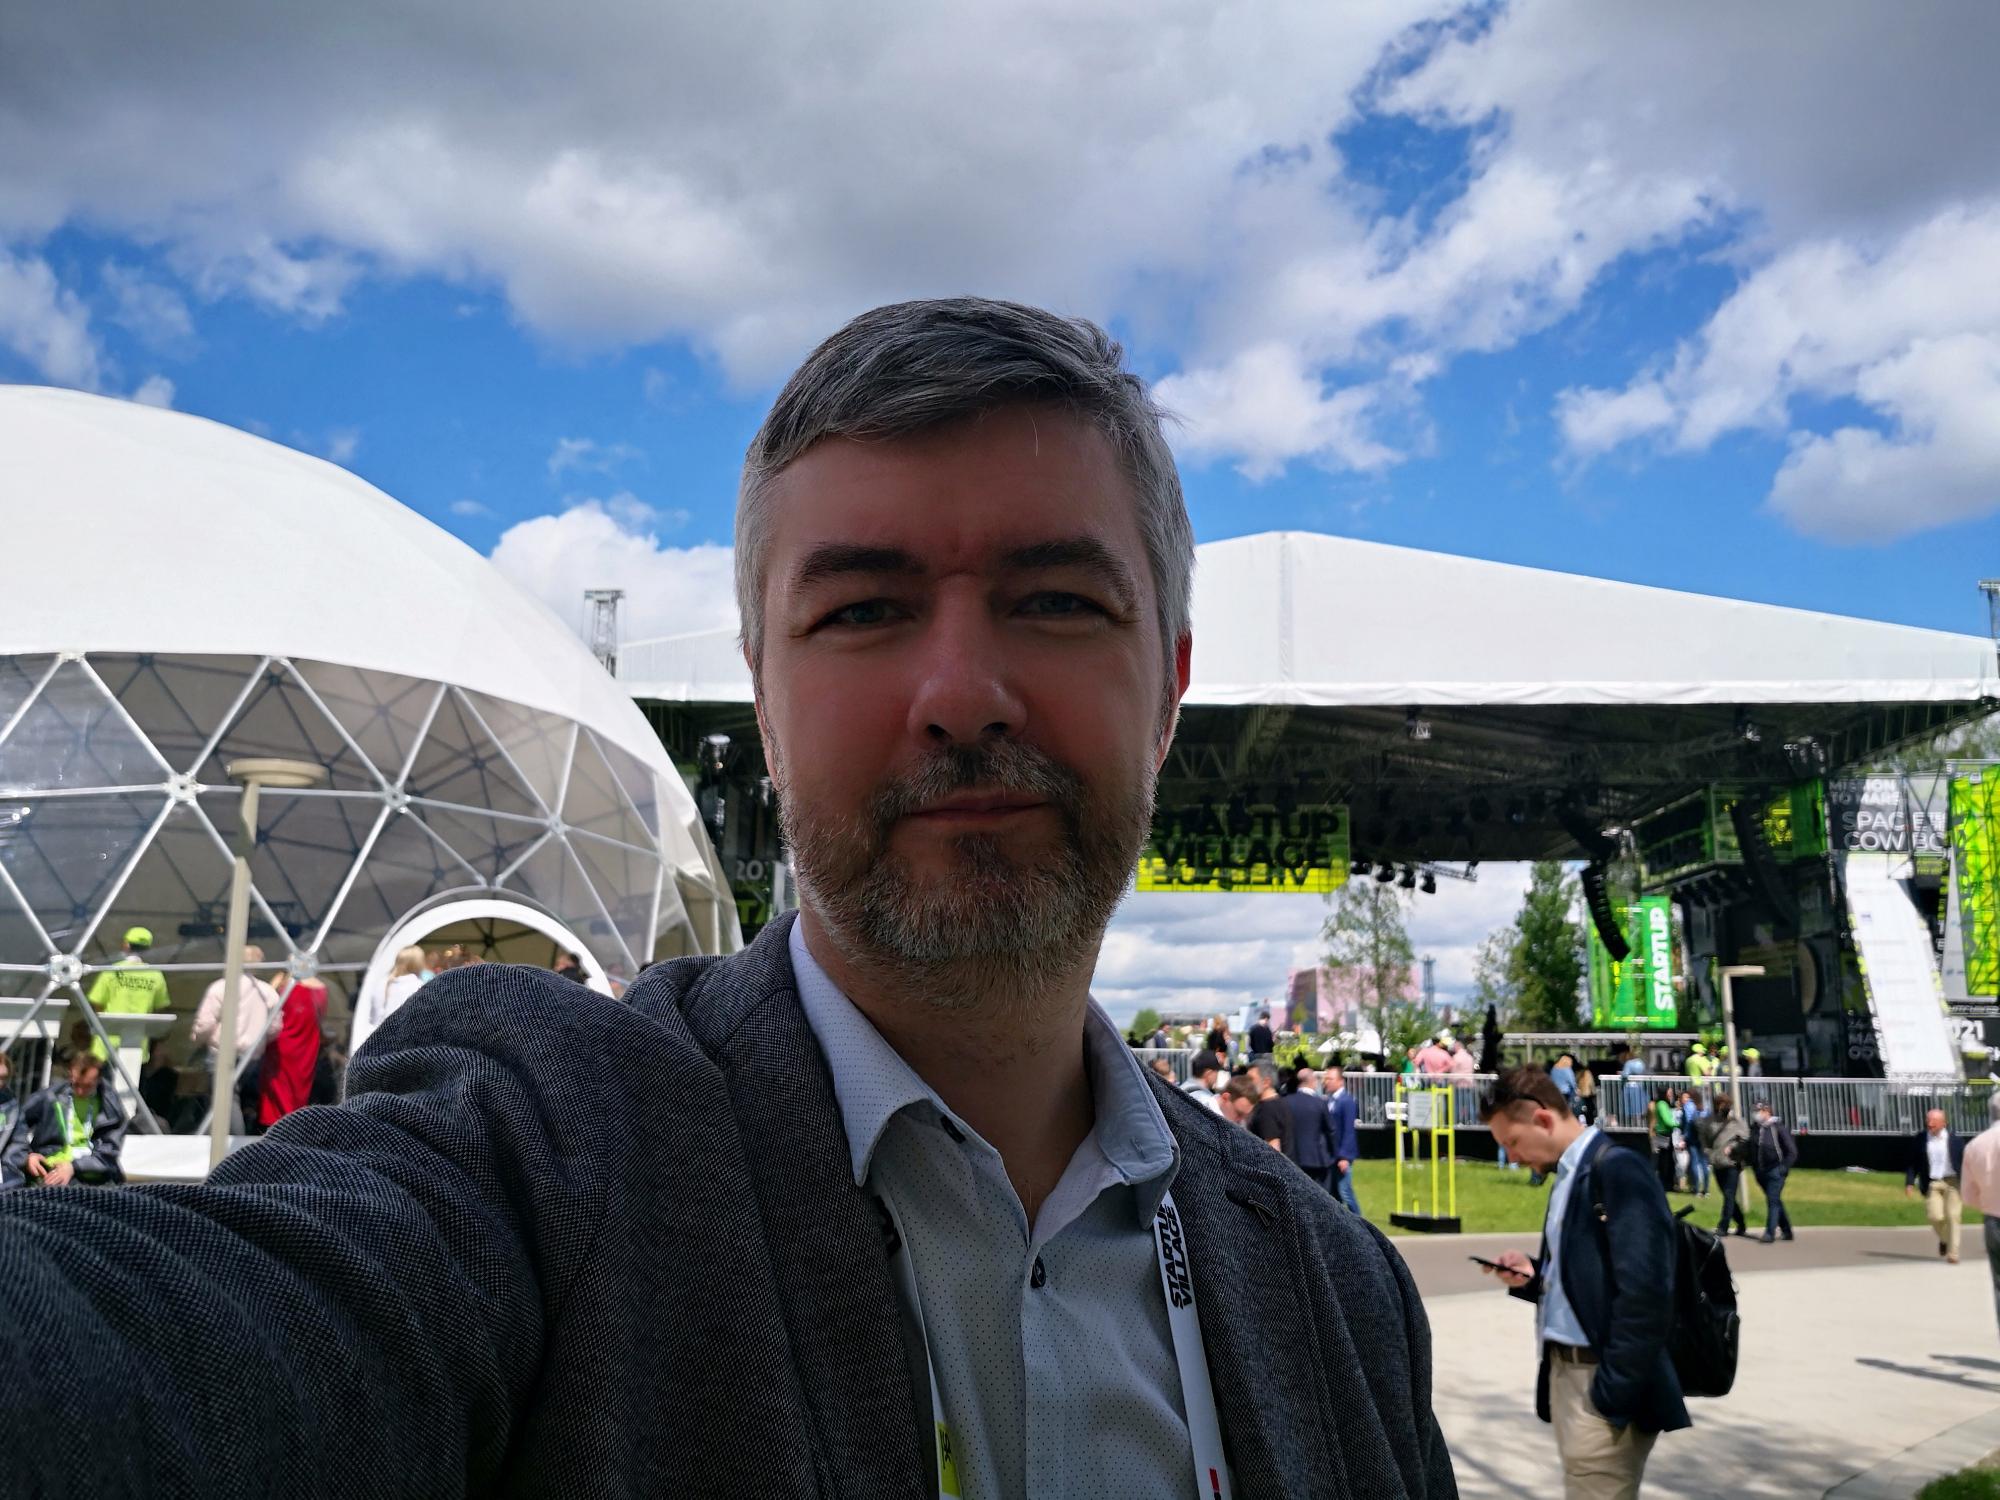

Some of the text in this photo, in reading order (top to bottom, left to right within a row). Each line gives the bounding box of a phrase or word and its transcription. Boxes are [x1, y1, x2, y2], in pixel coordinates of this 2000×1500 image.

[1842, 810, 1928, 832] SPACE
[1649, 906, 1676, 1011] STARTUP
[1165, 1204, 1192, 1306] VILLAGE
